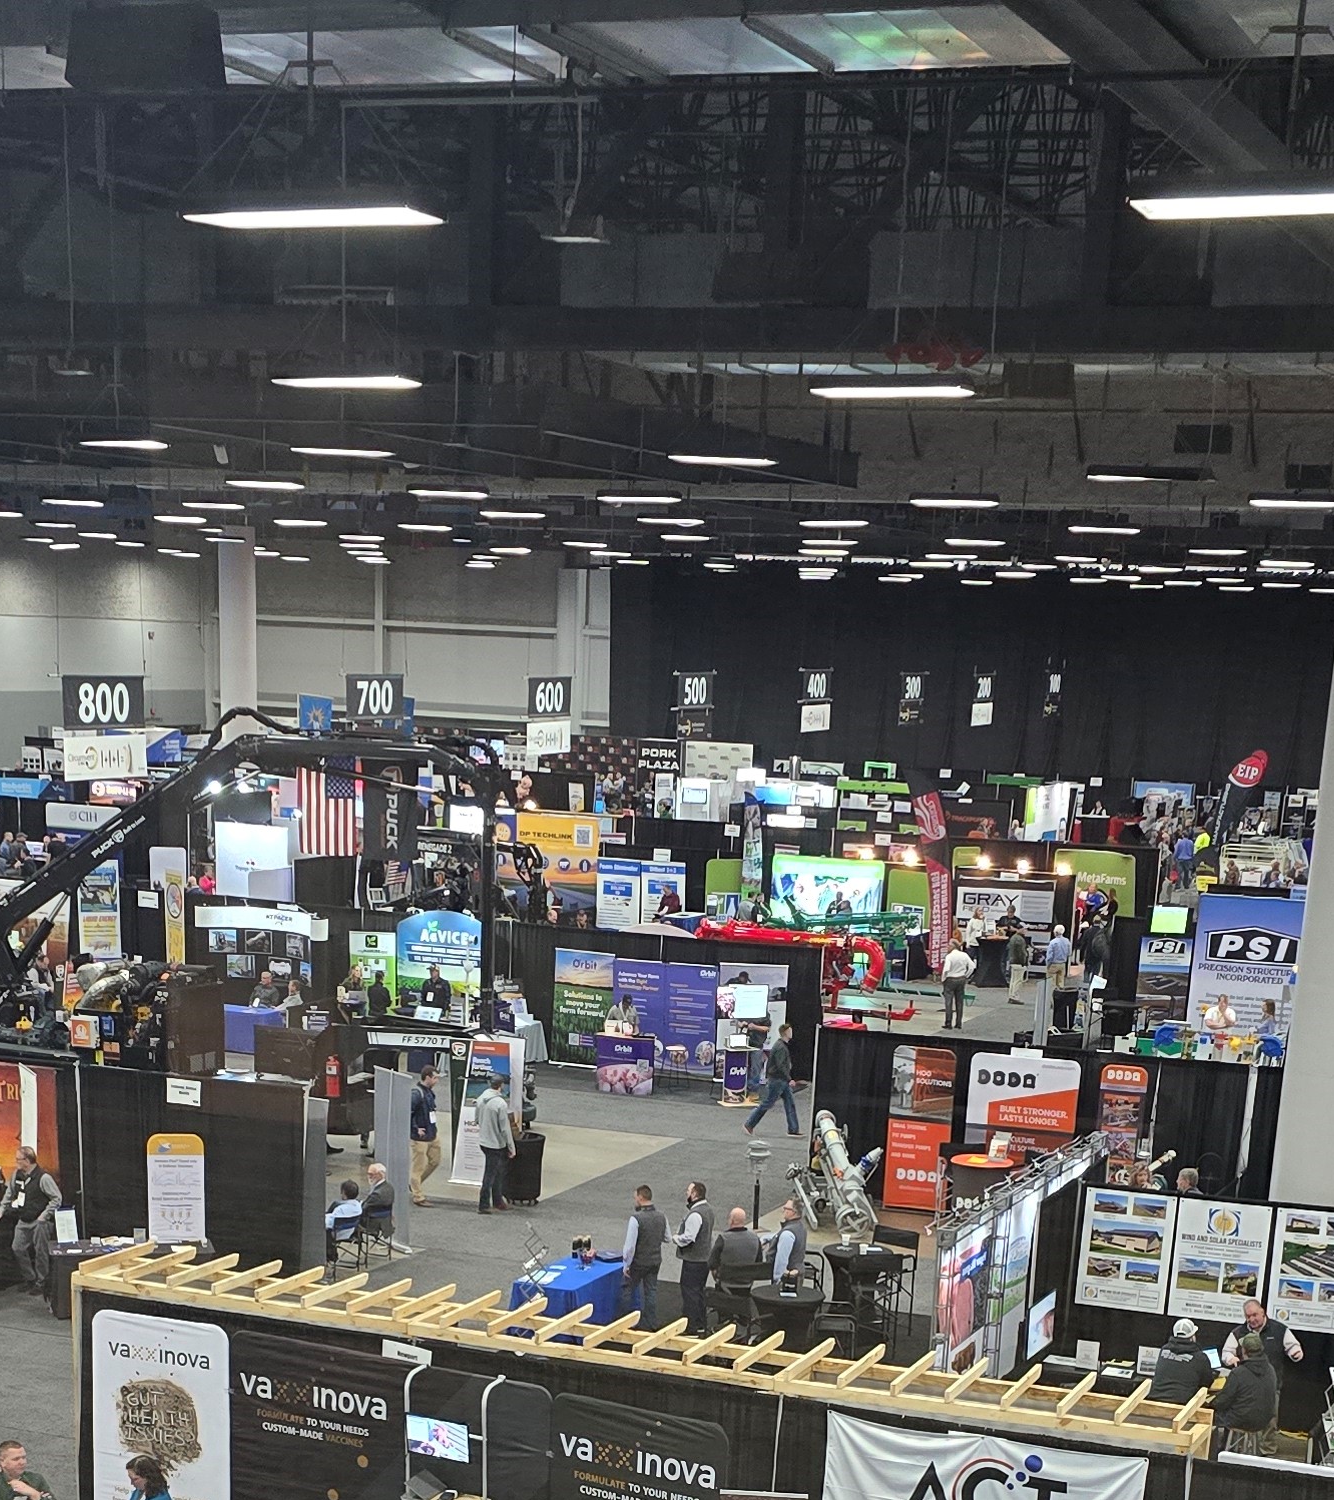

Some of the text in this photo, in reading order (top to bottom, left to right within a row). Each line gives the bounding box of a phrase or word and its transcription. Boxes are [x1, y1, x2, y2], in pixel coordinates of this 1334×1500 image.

[684, 677, 707, 705] 500
[808, 673, 826, 698] 400
[905, 675, 921, 699] 300
[977, 676, 992, 699] 200
[1049, 673, 1061, 694] 100
[78, 682, 129, 724] 800
[356, 680, 393, 715] 700
[535, 681, 563, 712] 600
[641, 747, 677, 759] PORK
[638, 759, 679, 770] PLAZA
[1236, 763, 1258, 779] EIP
[386, 792, 399, 849] PUCK
[91, 839, 115, 858] PUCK
[1078, 872, 1126, 885] MetaFarms
[963, 892, 1019, 906] GRAY
[1150, 941, 1183, 954] PSI
[1217, 935, 1290, 961] PSI
[573, 959, 597, 970] Orbit
[1198, 963, 1241, 972] PRECISION
[1216, 973, 1283, 985] INCORPORATED
[564, 990, 593, 1000] Solutions
[560, 1007, 605, 1017] farm forward.
[402, 1034, 448, 1047] FF 5770 T
[977, 1069, 1037, 1089] DODA
[999, 1105, 1068, 1119] BUILT STRONGER.
[999, 1114, 1059, 1126] LASTS LONGER.
[1210, 1236, 1226, 1245] SOLAR
[1228, 1239, 1262, 1248] SPECIALISTS
[108, 1340, 211, 1370] vaxxinova
[127, 1391, 159, 1406] GUT
[127, 1411, 189, 1426] HEALTH
[560, 1433, 717, 1489] vaxxinova
[574, 1470, 626, 1491] FORMULATE
[628, 1483, 641, 1494] TO
[643, 1485, 667, 1499] YOUR
